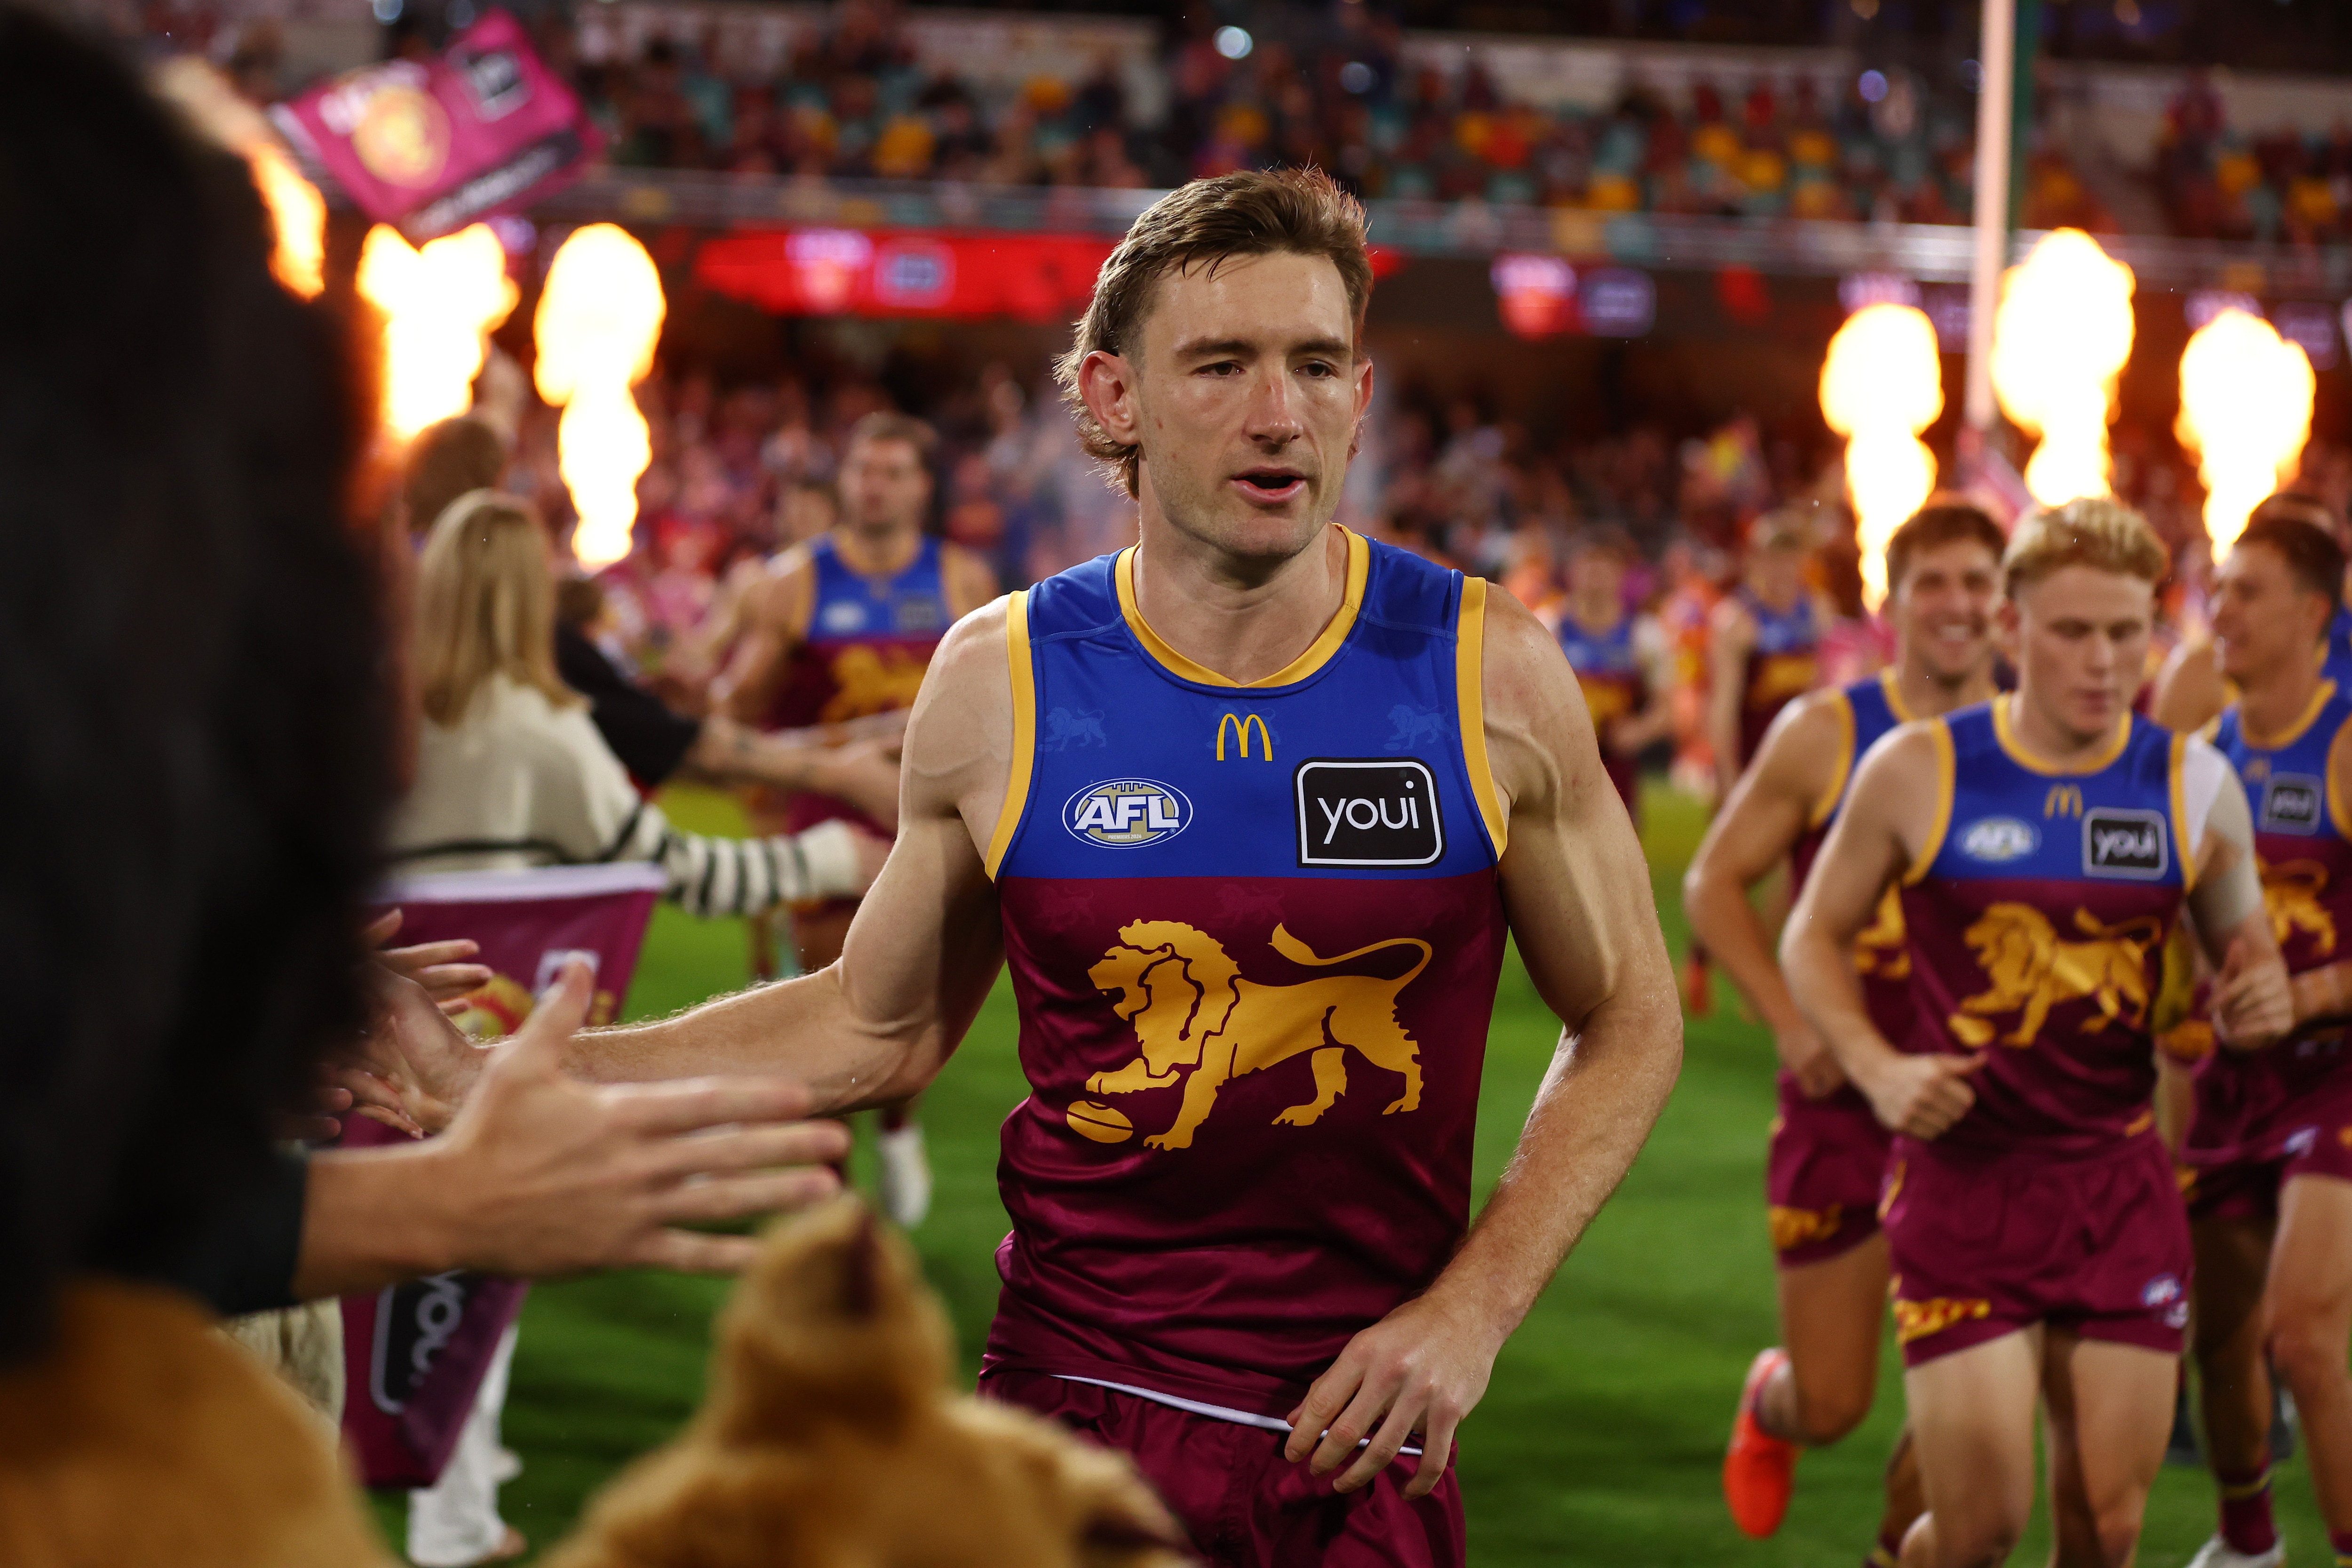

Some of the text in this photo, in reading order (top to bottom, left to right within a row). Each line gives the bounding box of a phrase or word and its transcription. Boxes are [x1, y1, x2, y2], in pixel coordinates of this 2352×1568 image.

[1073, 795, 1180, 830] AFL
[1317, 780, 1420, 844] youi
[408, 1269, 467, 1387] you
